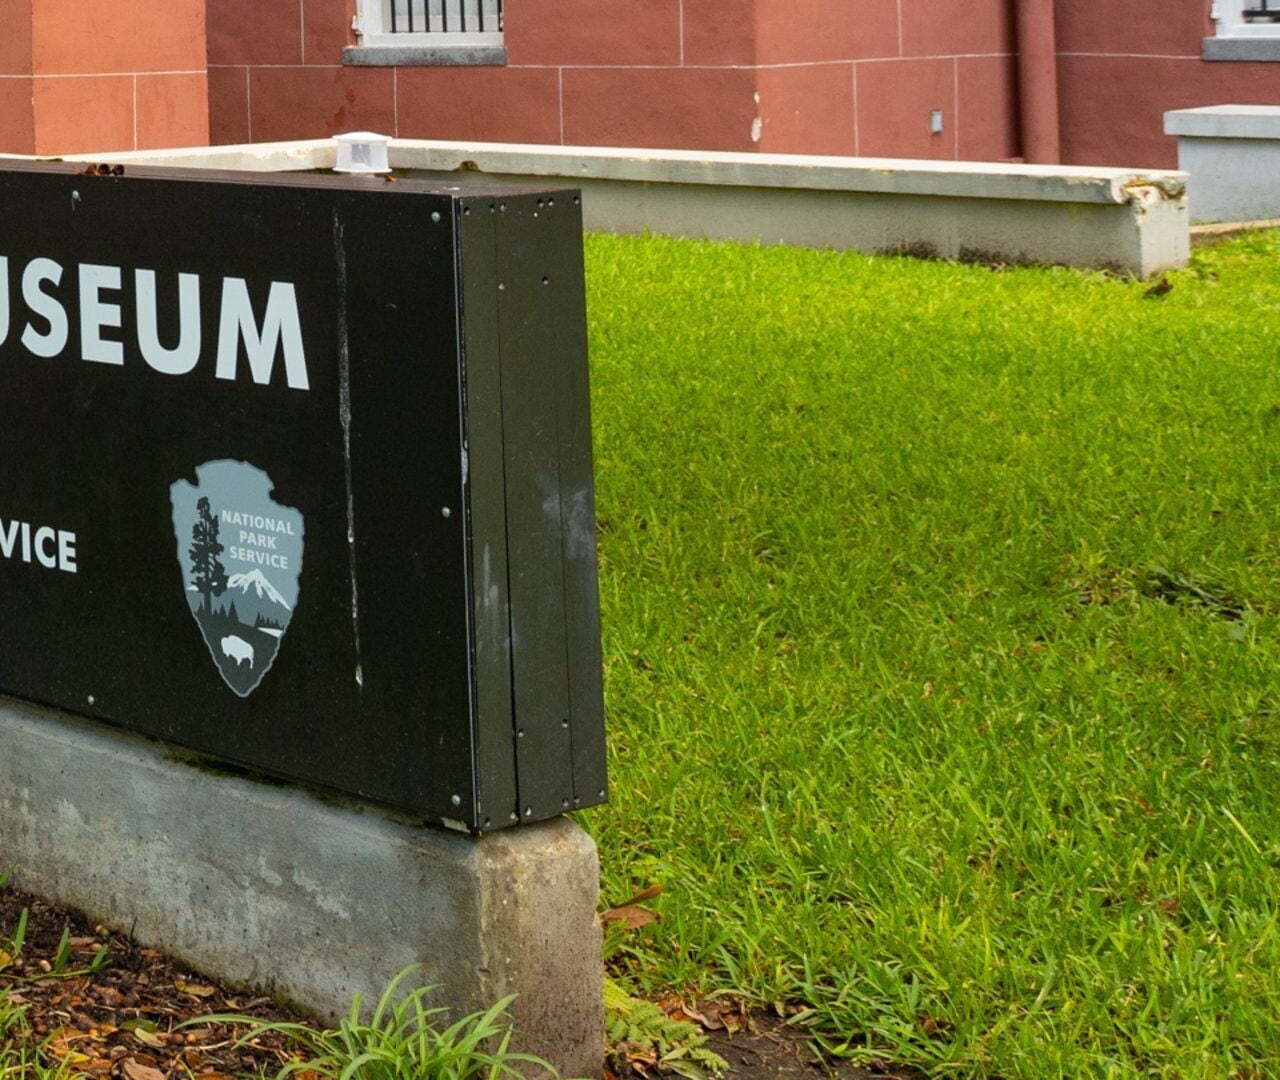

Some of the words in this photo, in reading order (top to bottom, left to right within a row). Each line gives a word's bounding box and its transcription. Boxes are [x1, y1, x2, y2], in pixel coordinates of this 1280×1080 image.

[221, 509, 295, 535] NATIONAL
[239, 530, 277, 550] PARK
[229, 546, 289, 570] SERVICE
